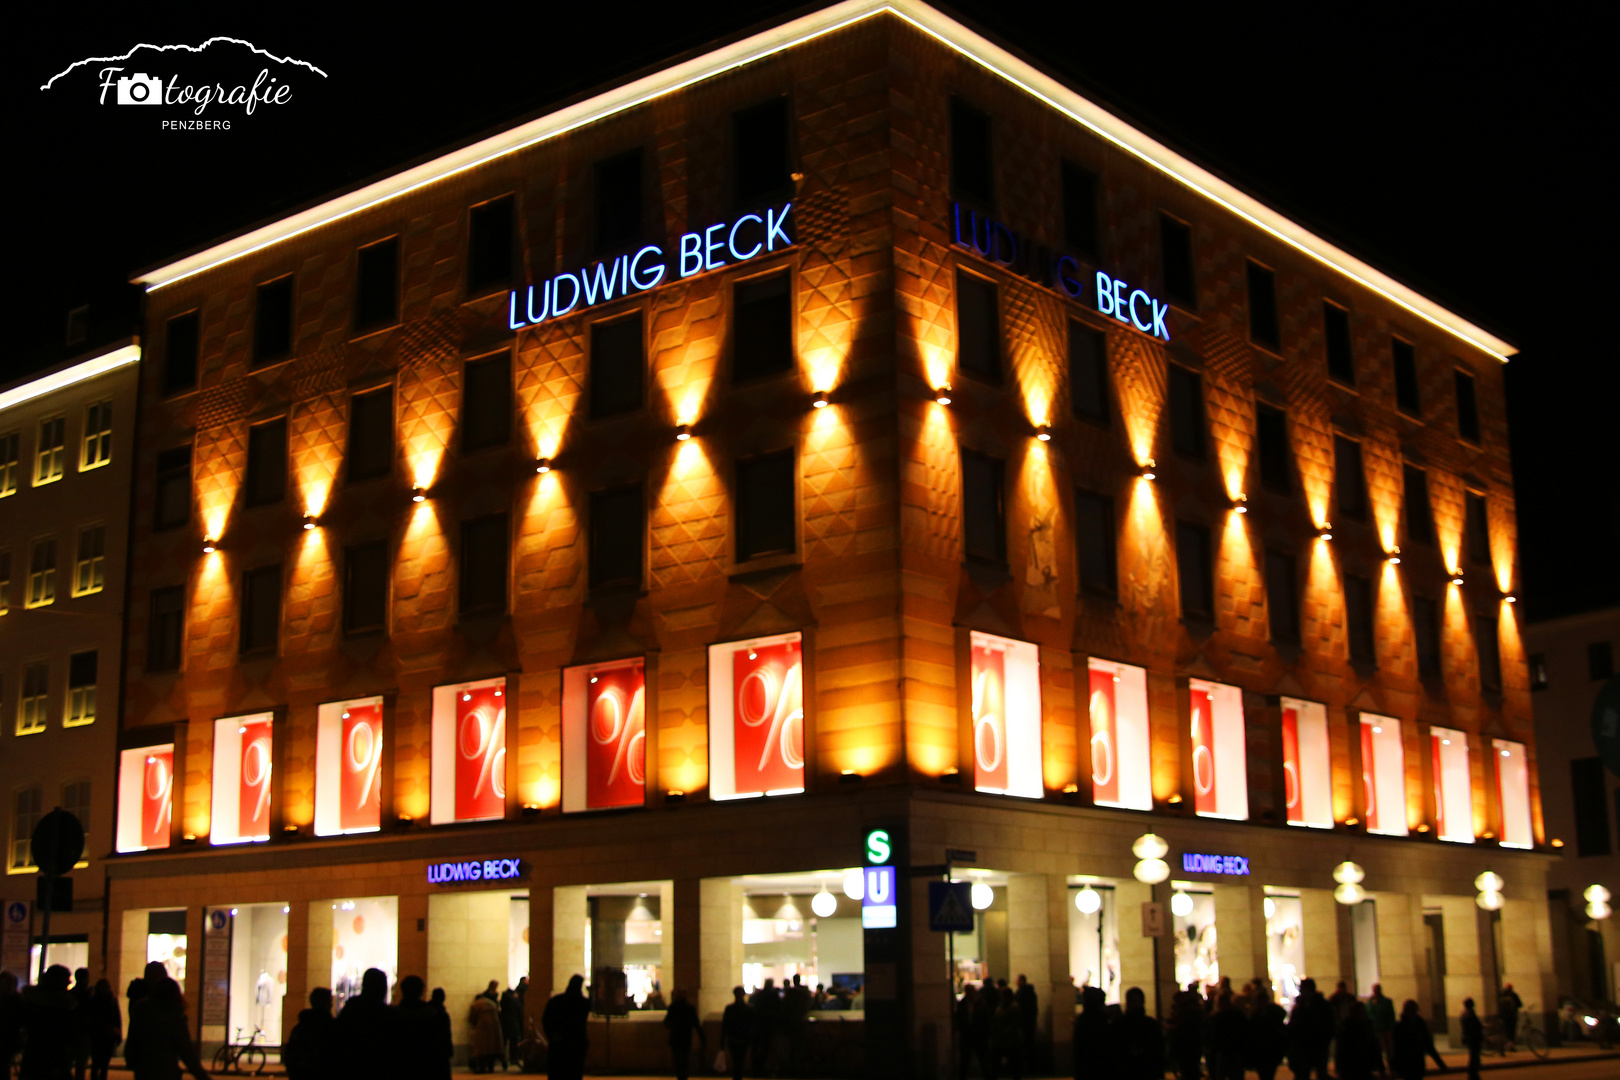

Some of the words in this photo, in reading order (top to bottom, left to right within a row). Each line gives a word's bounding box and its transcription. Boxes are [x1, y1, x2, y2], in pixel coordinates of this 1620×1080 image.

[508, 245, 666, 330] LUDWIG
[680, 202, 793, 278] BECK
[954, 202, 1083, 298] LUDG
[1096, 271, 1171, 342] BECK
[867, 830, 891, 864] S
[1182, 852, 1223, 875] LUDWIG
[1223, 855, 1250, 876] BECK
[427, 861, 482, 883] LUDWIG
[483, 858, 521, 880] BECK
[867, 870, 890, 904] U
